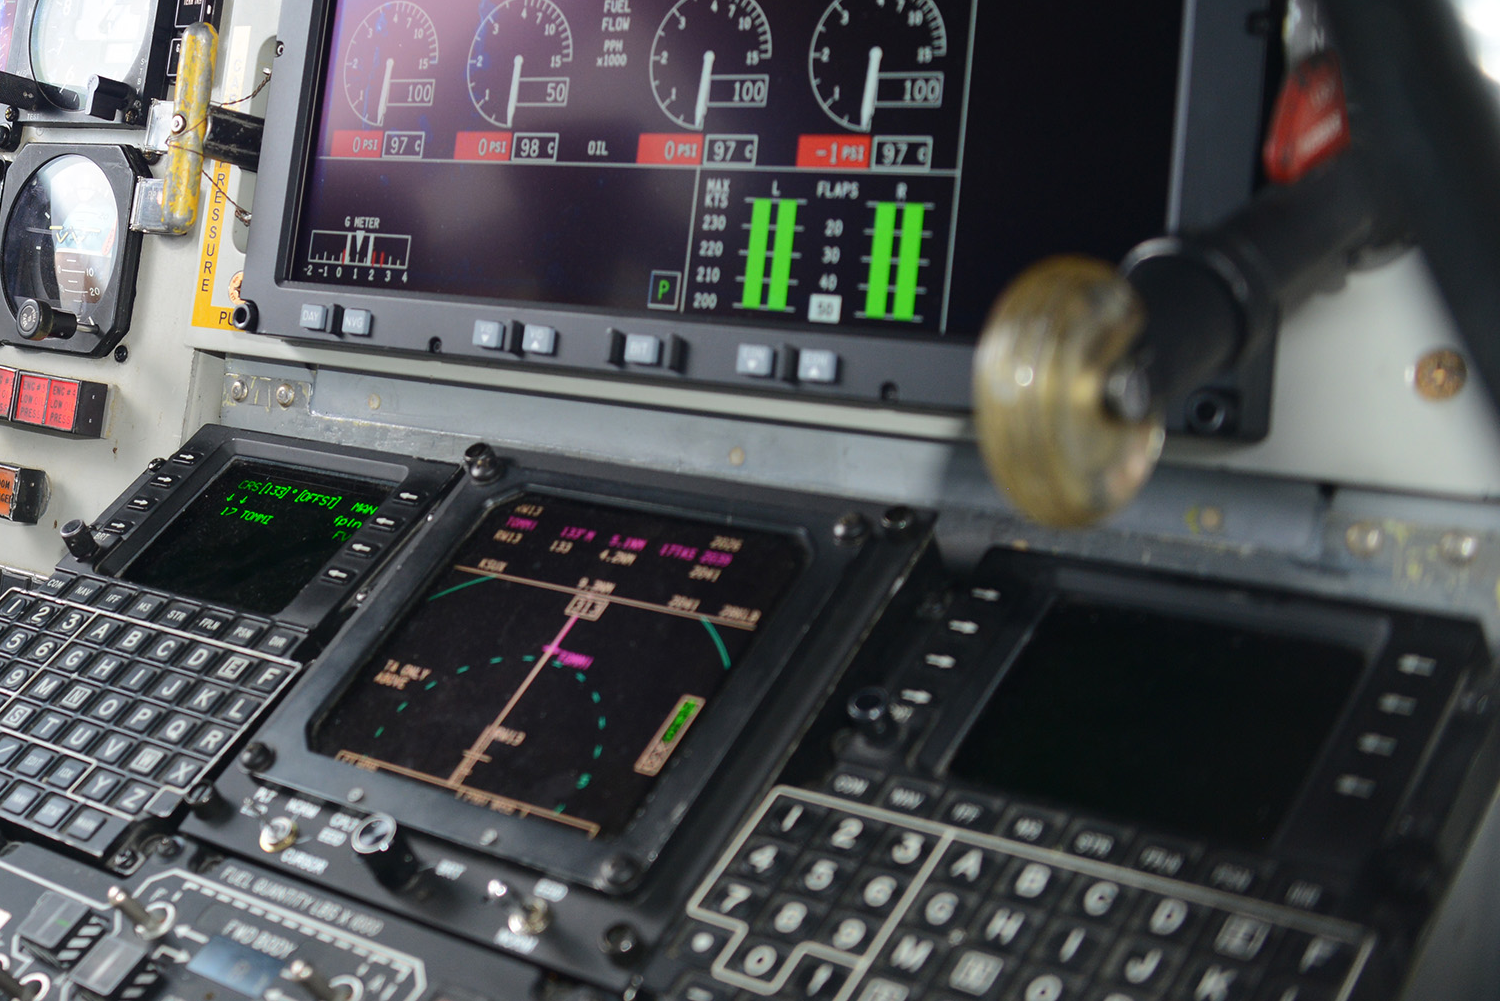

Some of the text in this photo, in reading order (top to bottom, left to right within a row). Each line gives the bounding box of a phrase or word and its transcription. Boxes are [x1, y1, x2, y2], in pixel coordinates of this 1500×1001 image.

[604, 0, 631, 13] FUEL
[602, 18, 629, 32] FLOW
[407, 84, 432, 102] 100
[546, 83, 565, 102] 50
[733, 80, 765, 102] 100
[904, 80, 940, 102] 100
[352, 136, 408, 153] 0 PSI 97
[478, 138, 539, 157] 0 PSI 98
[587, 141, 608, 155] OIL
[816, 180, 860, 199] FLAPS
[344, 217, 379, 229] G METER
[702, 215, 726, 230] 230
[825, 219, 843, 237] 20
[699, 241, 723, 257] 220
[821, 246, 840, 264] 30
[85, 268, 94, 277] 10
[696, 266, 720, 283] 210
[658, 280, 669, 299] P
[819, 273, 838, 291] 40
[89, 287, 100, 297] 20
[693, 292, 717, 309] 200
[302, 310, 364, 328] DAY NVG
[238, 480, 262, 492] CRS
[351, 502, 378, 515] MAN
[240, 510, 274, 525] TOMMI
[47, 577, 286, 649] COM NAV IFF M3 STR FPLN PSN DIR
[6, 633, 21, 649] 5
[36, 642, 52, 658] 6
[7, 599, 276, 685] 1 2 3 A B C D E F
[6, 669, 23, 686] 9
